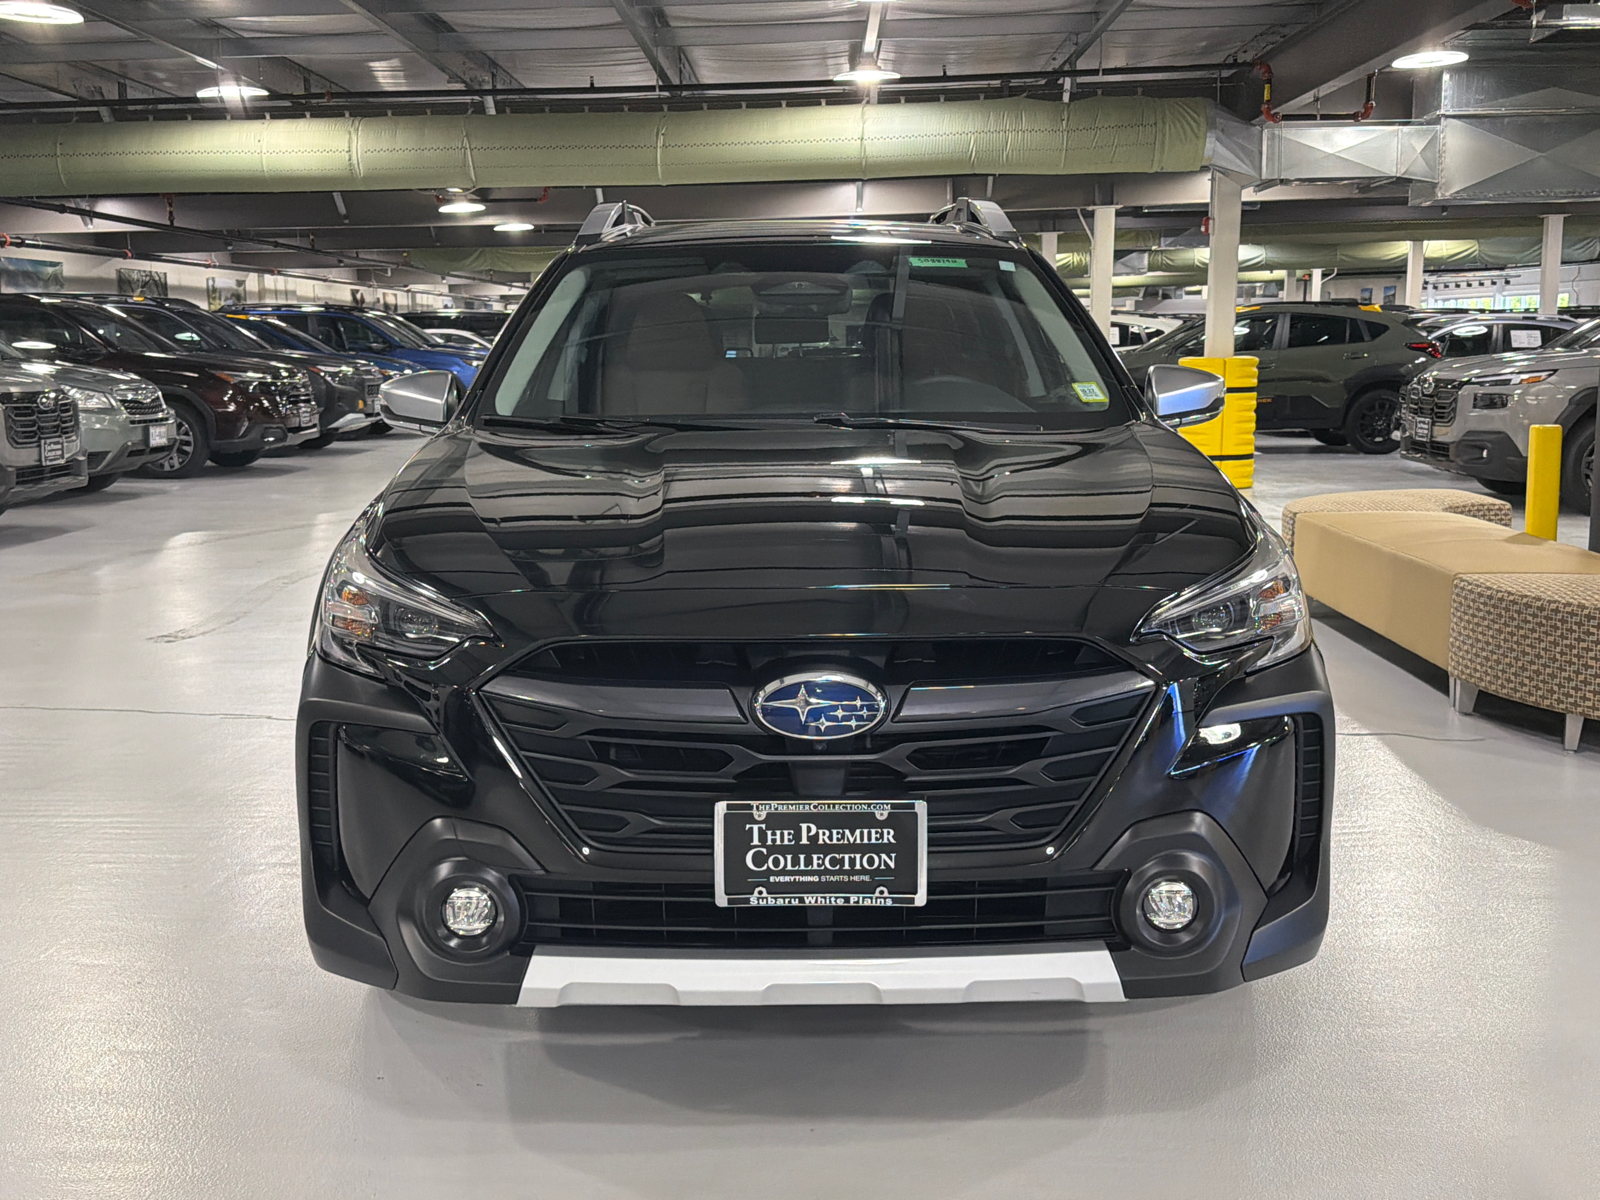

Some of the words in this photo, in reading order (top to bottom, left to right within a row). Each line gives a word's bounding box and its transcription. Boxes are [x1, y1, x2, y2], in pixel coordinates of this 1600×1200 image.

[745, 823, 795, 846] THE
[799, 823, 897, 845] PREMIER
[745, 848, 896, 871] COLLECTION
[749, 896, 799, 905] Subaru
[804, 896, 845, 905] White
[850, 896, 893, 905] Plains
